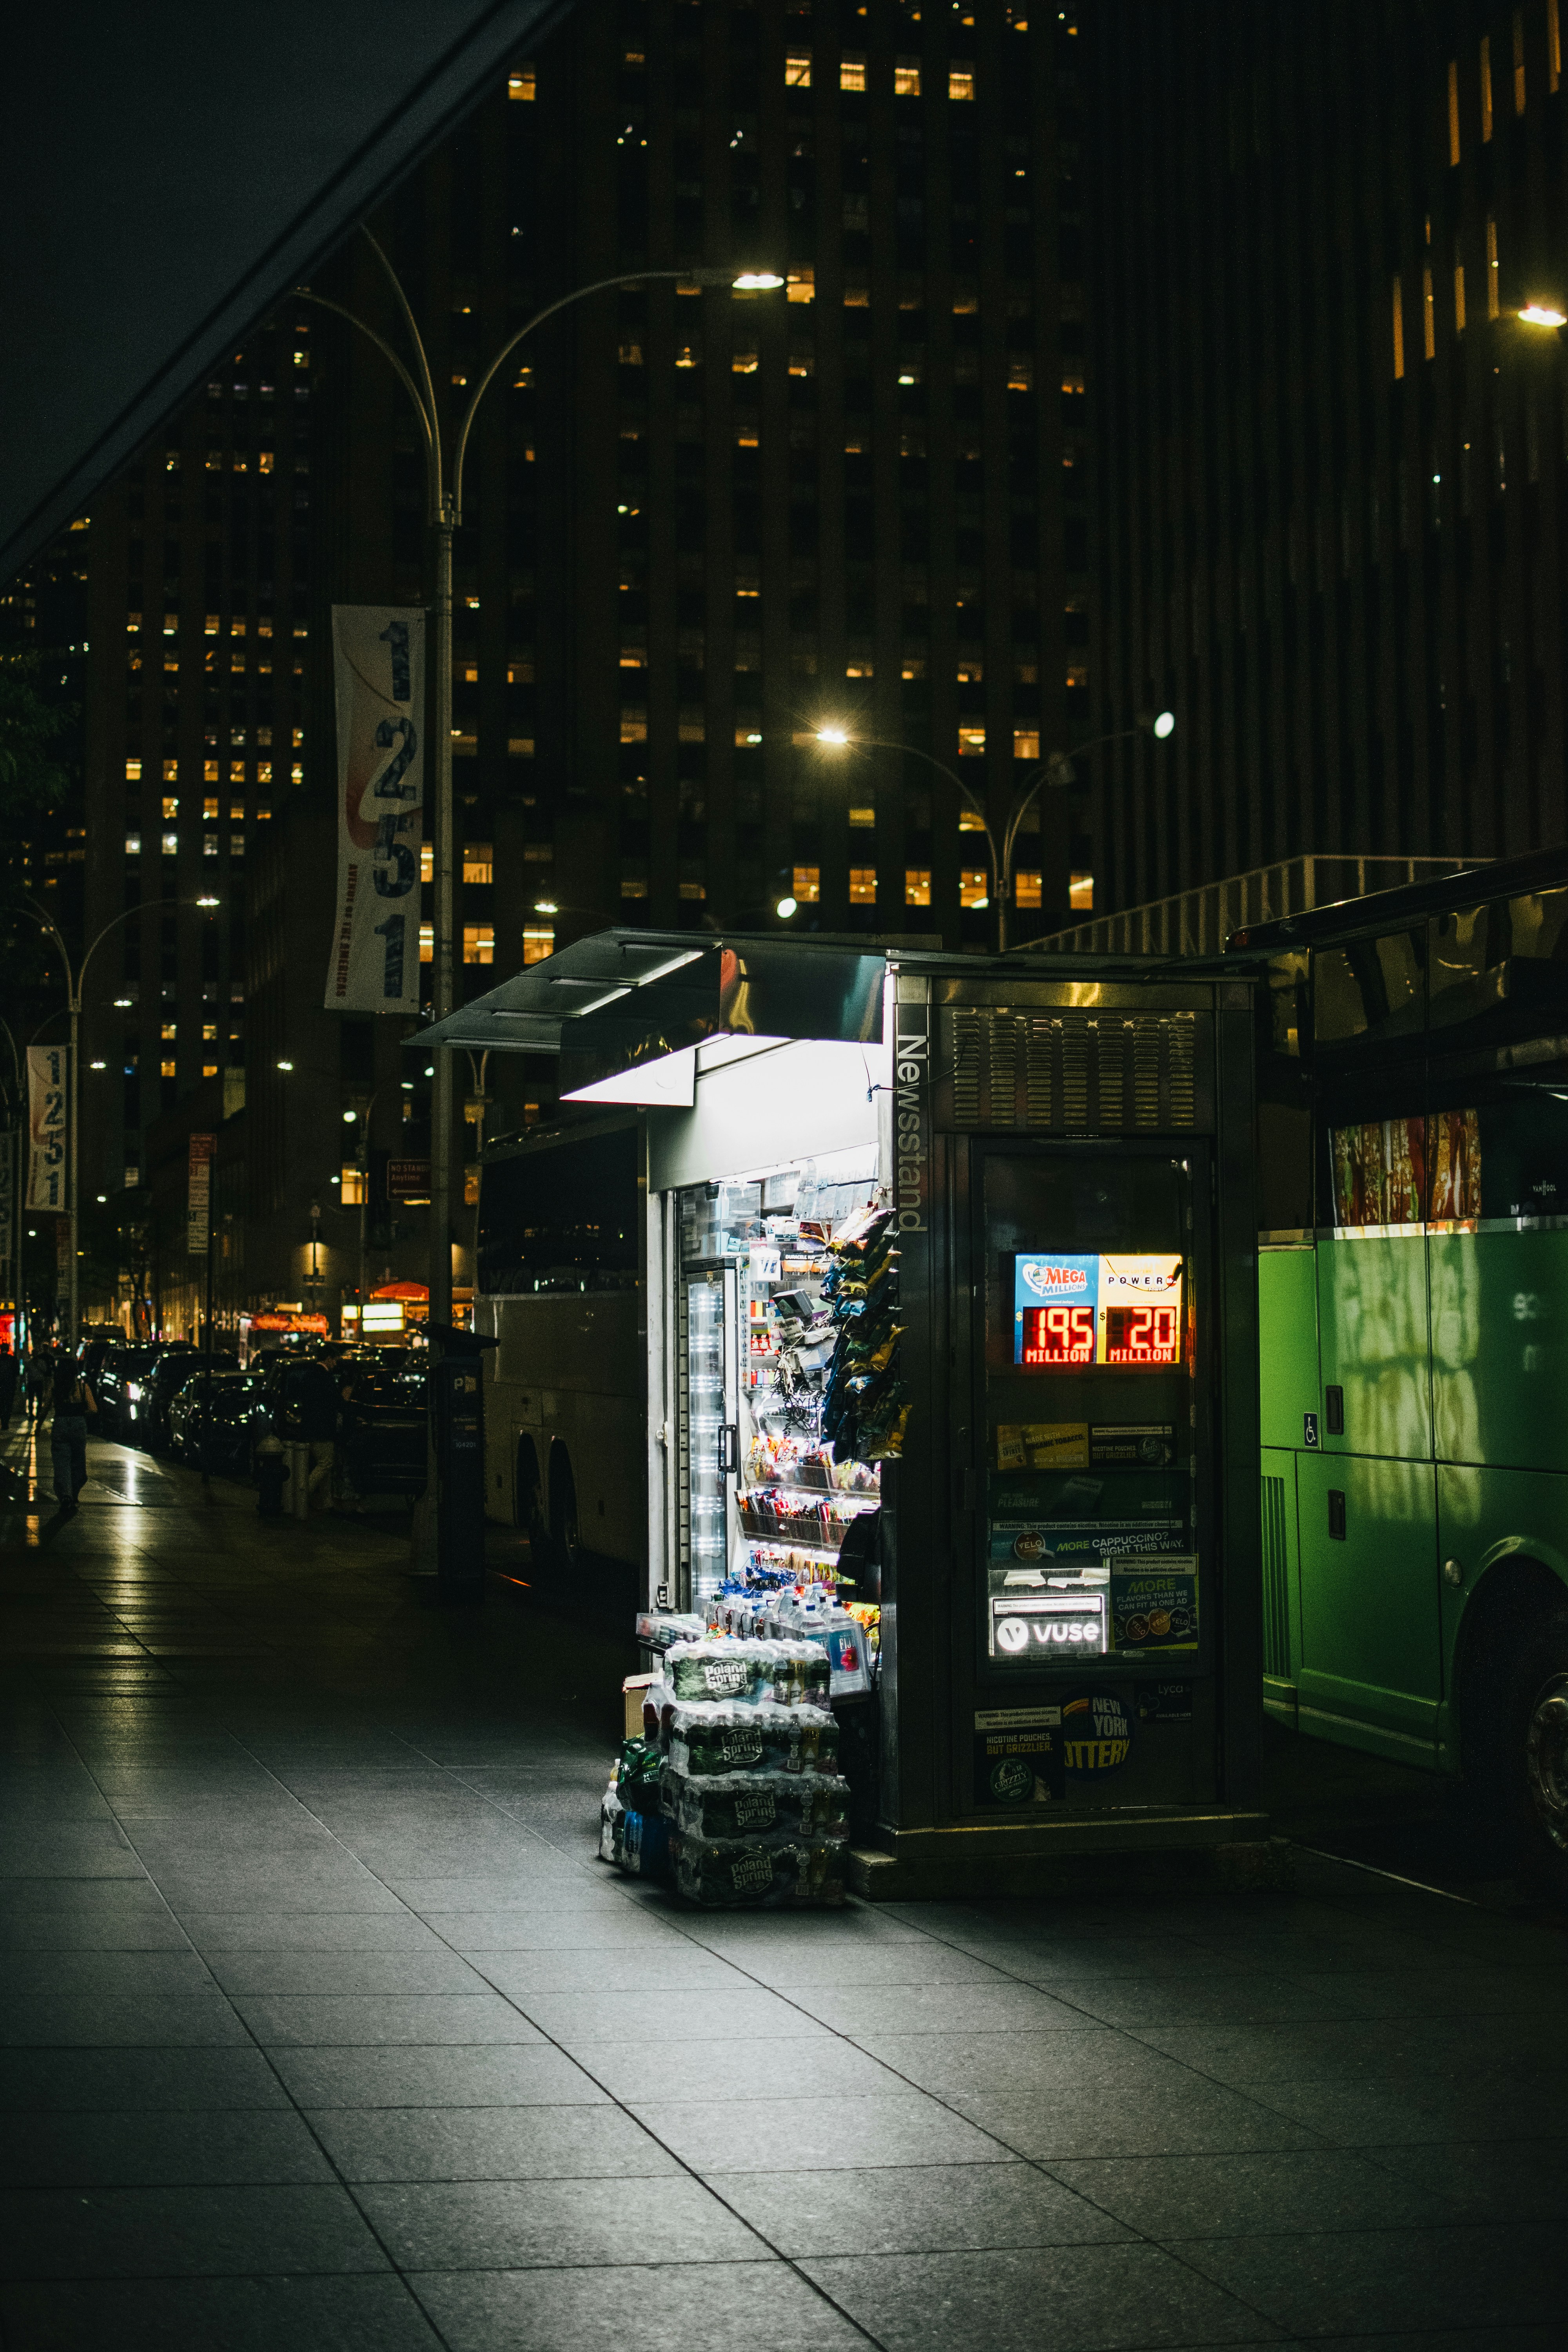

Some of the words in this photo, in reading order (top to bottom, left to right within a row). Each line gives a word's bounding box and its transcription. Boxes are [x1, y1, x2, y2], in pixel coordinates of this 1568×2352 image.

[347, 864, 358, 902] AVENUE
[345, 906, 353, 918] OF
[341, 922, 352, 940] THE
[336, 943, 350, 997] AMERICAS
[898, 1034, 927, 1232] Newsstand
[391, 1164, 401, 1172] NO
[391, 1174, 421, 1183] Anytime
[1044, 1267, 1085, 1285] MEGA
[1042, 1284, 1085, 1294] MILLIONS
[1039, 1308, 1093, 1350] 195
[1131, 1308, 1175, 1349] 20
[1026, 1349, 1090, 1362] MILLION
[1110, 1349, 1172, 1361] MILLION
[1026, 1441, 1054, 1450] ORGANIC
[1055, 1434, 1085, 1445] TOBACCO.
[997, 1497, 1040, 1508] PLEASURE
[1017, 1540, 1042, 1550] VELO
[1056, 1540, 1090, 1552] MORE
[1092, 1531, 1169, 1548] CAPPUCCINO?
[1099, 1544, 1131, 1557] RIGHT
[1133, 1542, 1158, 1553] THIS
[1160, 1539, 1184, 1550] WAY.
[1127, 1577, 1176, 1594] MORE
[1116, 1593, 1152, 1603] FLAVORS
[1153, 1590, 1174, 1599] THAN
[1118, 1602, 1135, 1611] CAN
[1131, 1619, 1146, 1635] VELO
[1171, 1617, 1188, 1626] VELO
[1033, 1623, 1099, 1643] vuse
[704, 1661, 747, 1679] Poland
[706, 1673, 748, 1690] Spring
[1158, 1684, 1184, 1696] Lyca
[1092, 1697, 1122, 1715] NEW
[1093, 1715, 1129, 1737] YORK
[720, 1729, 761, 1748] Poland
[986, 1735, 1018, 1744] NICOTINE
[1019, 1733, 1052, 1742] POUCHES.
[722, 1742, 763, 1761] Spring
[986, 1744, 1004, 1755] BUT
[1005, 1741, 1054, 1754] GRIZZLIER.
[994, 1771, 1027, 1789] GRIZZLY
[734, 1793, 775, 1813] Poland
[736, 1806, 776, 1826] Spring
[730, 1856, 772, 1877] Poland
[733, 1869, 773, 1890] Spring
